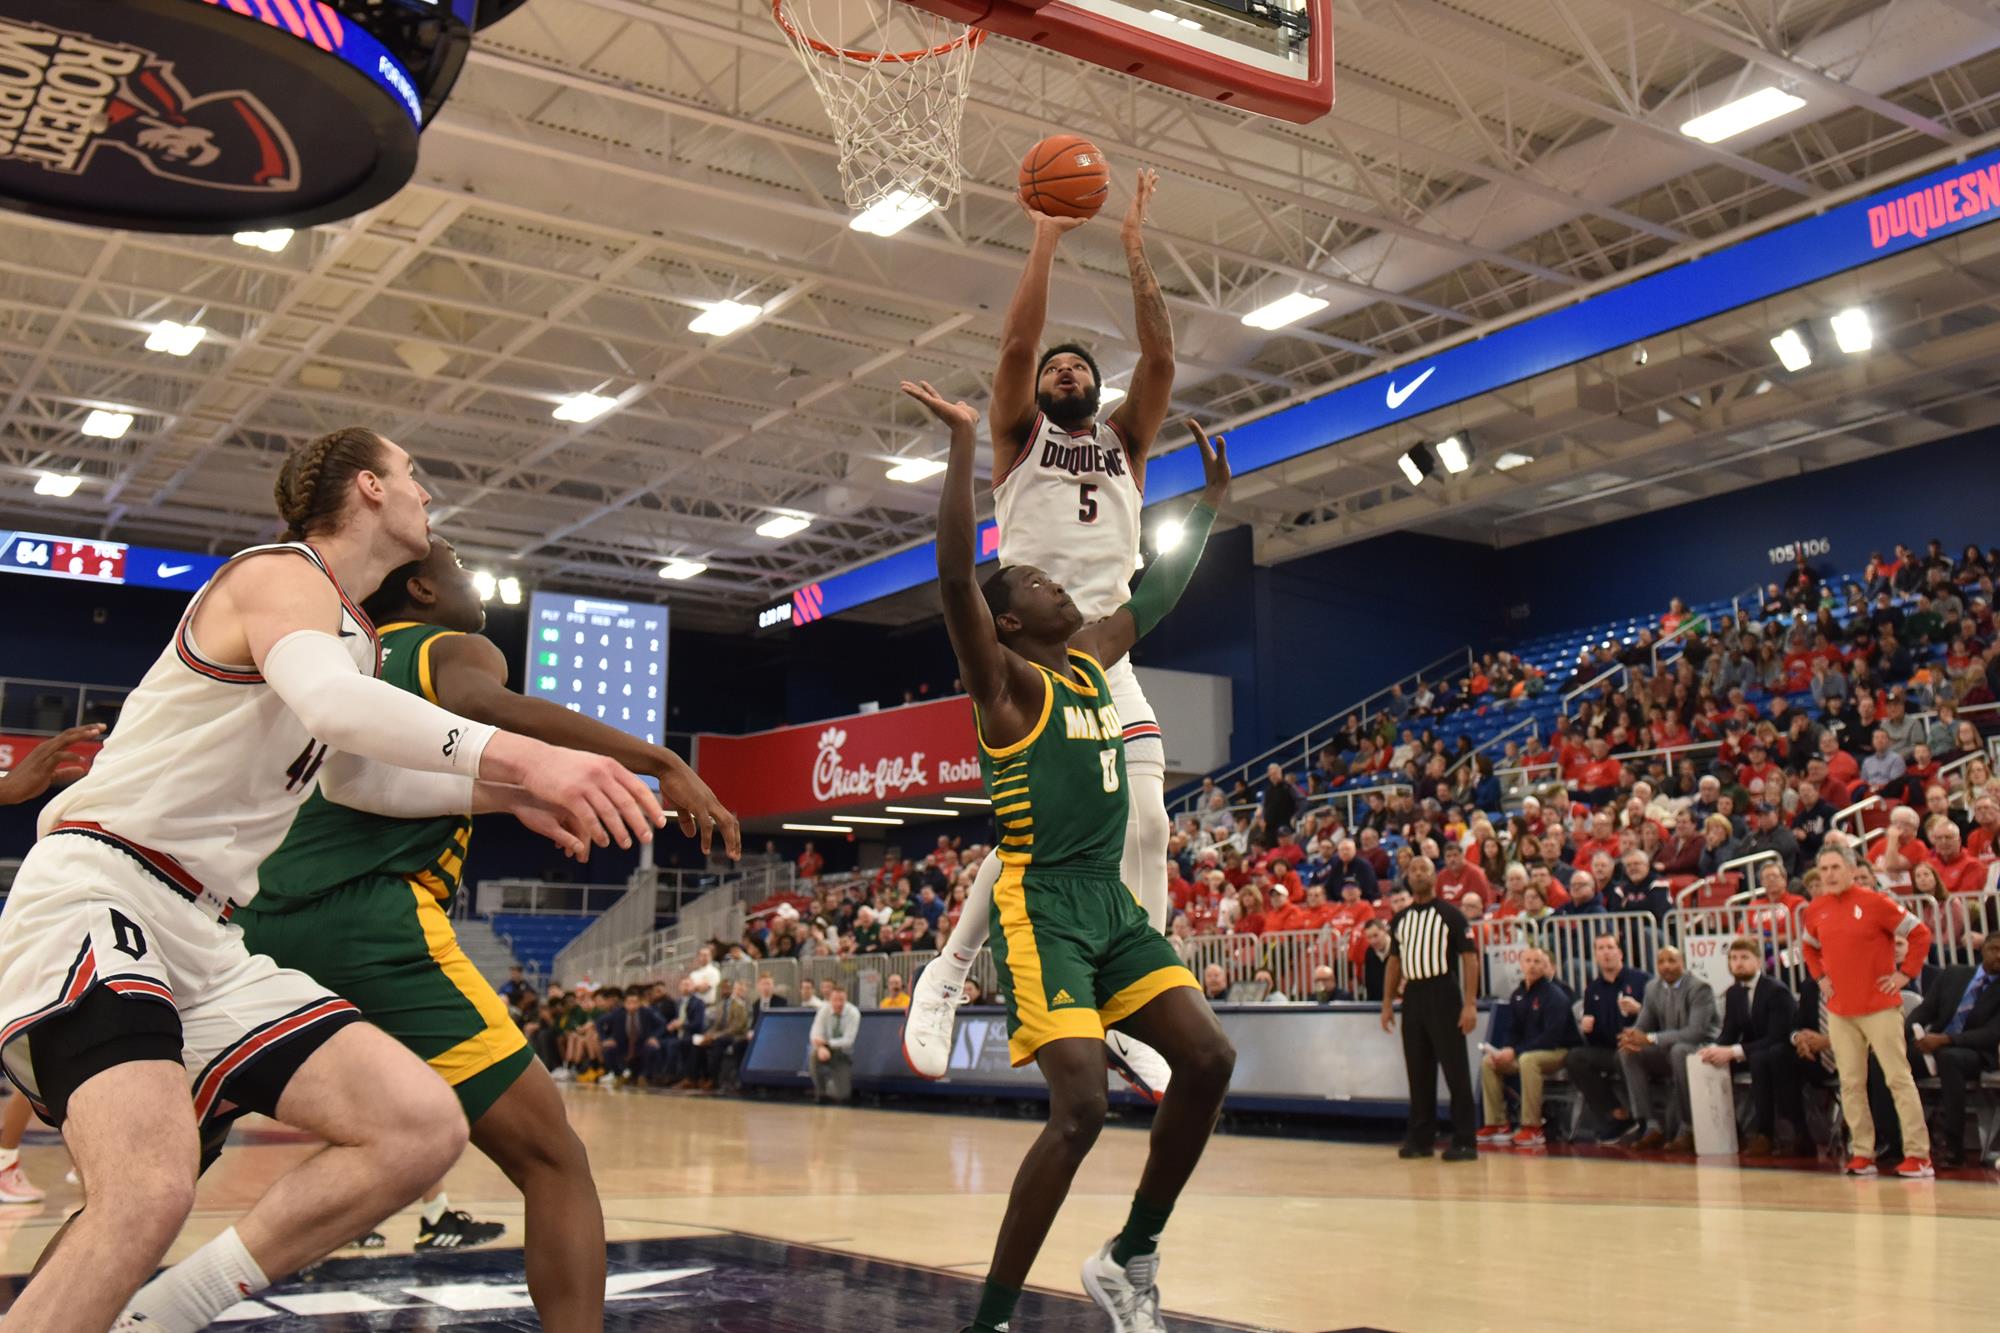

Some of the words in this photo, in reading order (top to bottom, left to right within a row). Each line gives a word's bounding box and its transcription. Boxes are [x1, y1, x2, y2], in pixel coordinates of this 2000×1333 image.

[0, 21, 58, 155] MOR
[14, 36, 141, 169] ROBERT
[1868, 162, 2000, 249] DUQUESN
[1040, 440, 1126, 477] DUQUENE
[1079, 483, 1098, 523] 5
[600, 634, 609, 647] 4
[650, 639, 659, 652] 2
[574, 655, 583, 669] 2
[598, 658, 608, 670] 4
[649, 663, 658, 675] 2
[597, 681, 607, 695] 2
[622, 683, 632, 696] 4
[648, 685, 657, 699] 2
[647, 709, 656, 722] 2
[812, 740, 928, 802] Chick-fil-A
[1100, 748, 1120, 793] 0
[1689, 941, 1718, 958] 107
